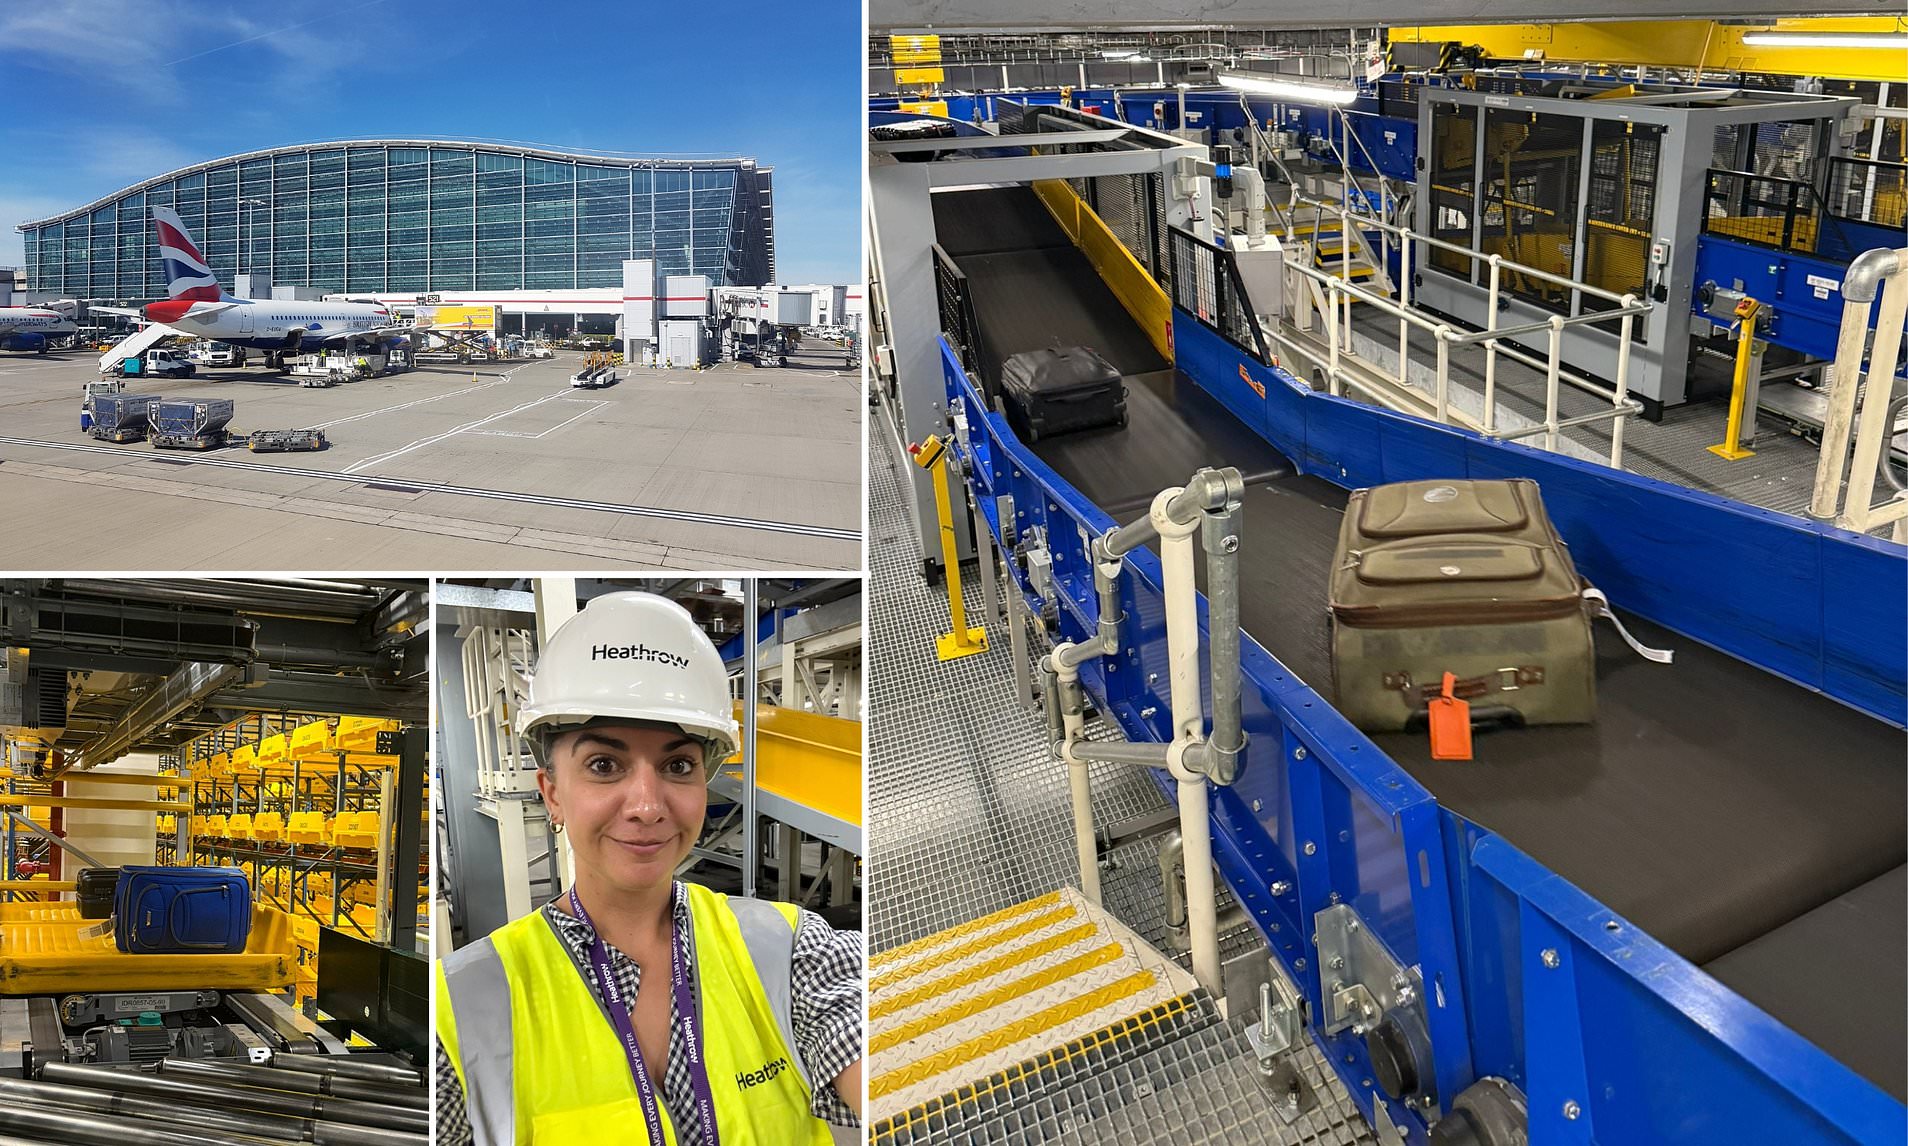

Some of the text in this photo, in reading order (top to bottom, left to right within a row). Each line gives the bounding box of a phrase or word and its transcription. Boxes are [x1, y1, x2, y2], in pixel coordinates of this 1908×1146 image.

[592, 644, 689, 670] Heathrow
[600, 963, 620, 1003] Heathrow
[626, 1032, 640, 1058] BETTER
[683, 1016, 698, 1064] Heathrow
[634, 1058, 651, 1095] JOURNEY
[645, 1095, 657, 1122] EVERY
[700, 1099, 714, 1134] MAKING
